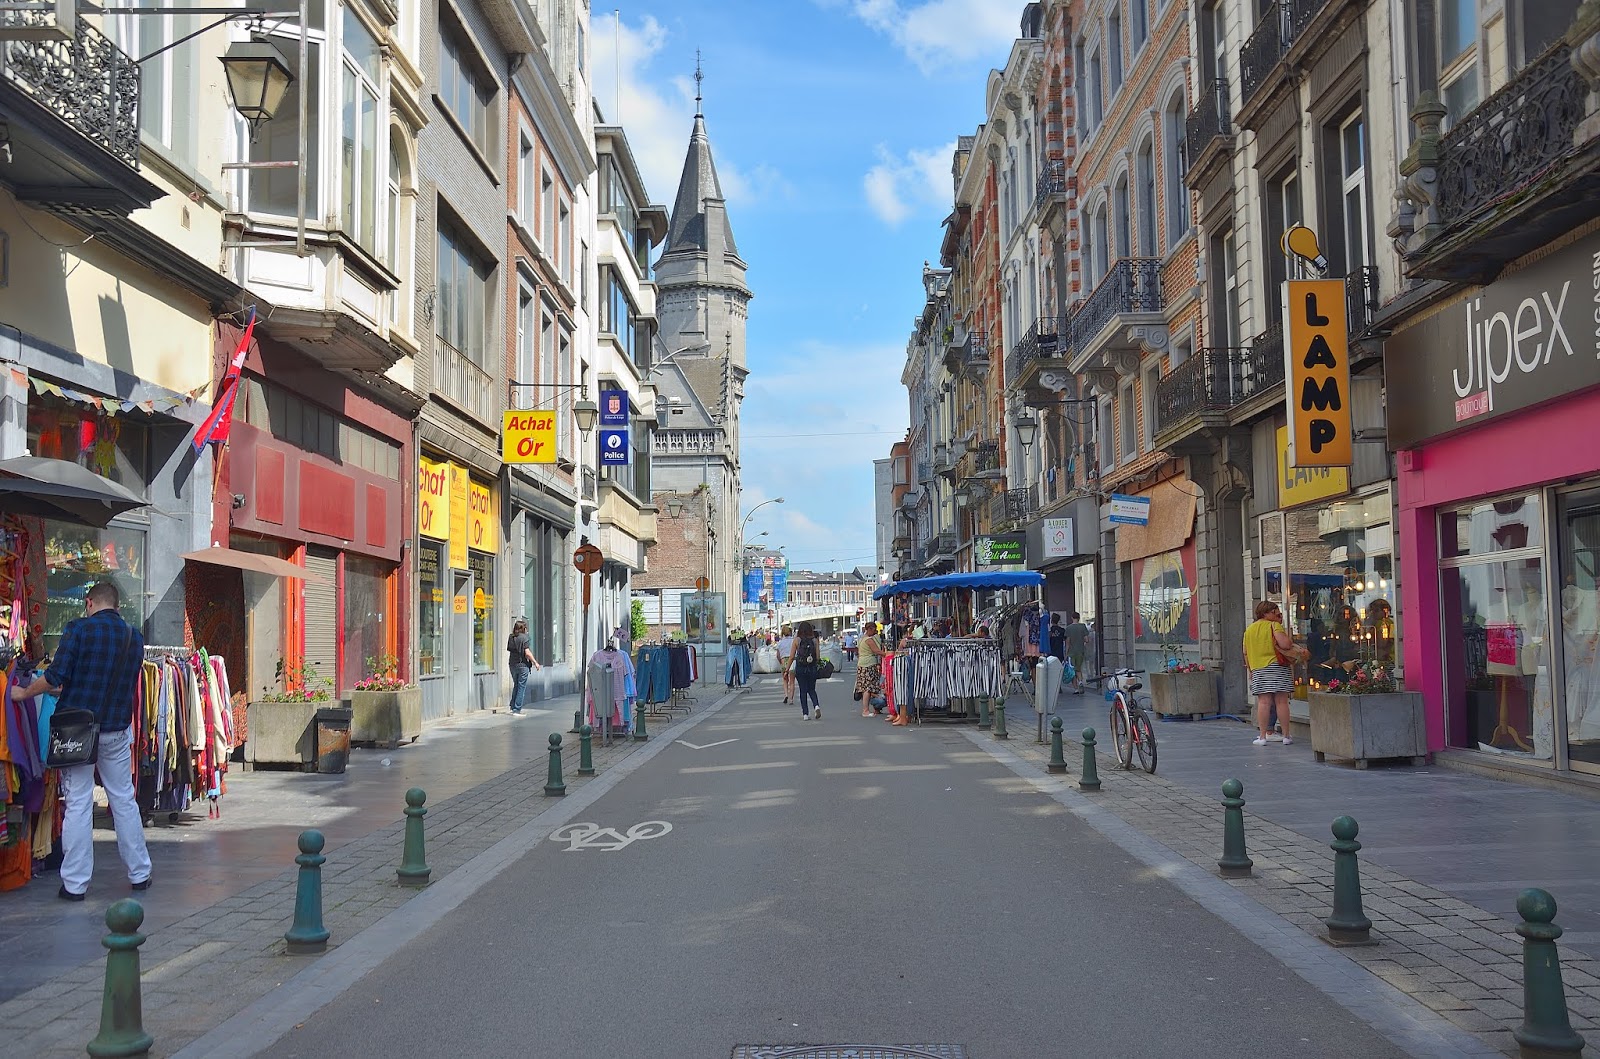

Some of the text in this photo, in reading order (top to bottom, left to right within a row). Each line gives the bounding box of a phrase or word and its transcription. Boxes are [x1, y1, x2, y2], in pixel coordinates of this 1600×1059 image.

[1453, 280, 1574, 412] Jipex
[1301, 292, 1341, 453] LAMP
[1455, 396, 1488, 417] BOUTIQUE
[507, 416, 553, 431] Achat
[517, 437, 544, 457] Or
[604, 451, 625, 459] Police
[420, 463, 446, 497] chat
[421, 500, 434, 532] Or
[474, 519, 484, 546] Or
[984, 540, 1020, 550] Fleuriste
